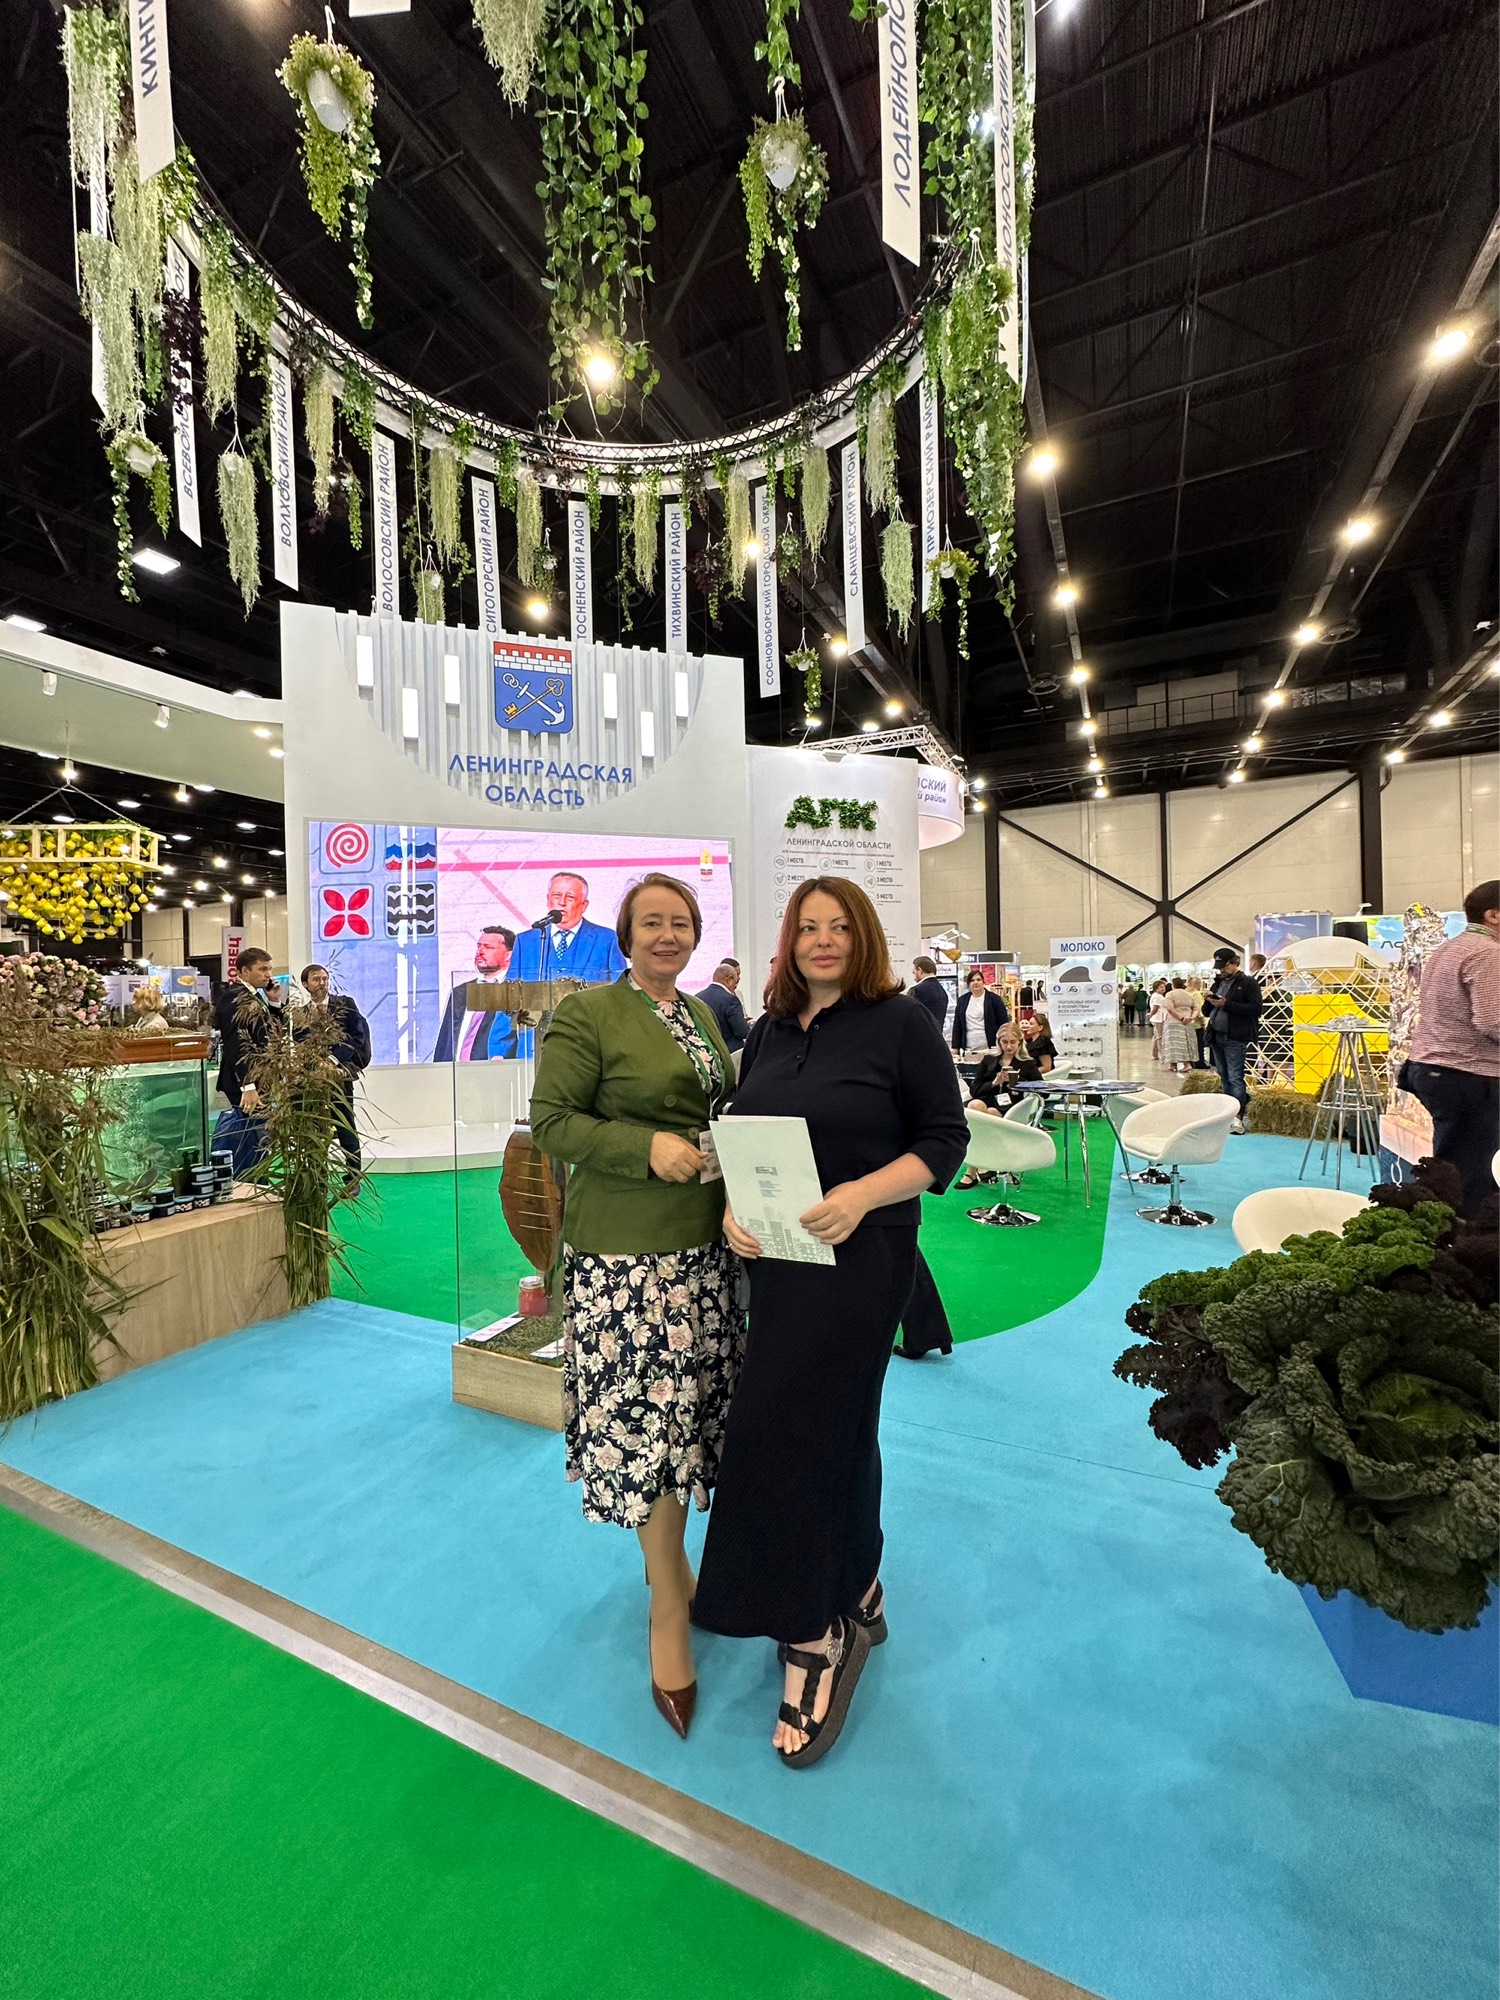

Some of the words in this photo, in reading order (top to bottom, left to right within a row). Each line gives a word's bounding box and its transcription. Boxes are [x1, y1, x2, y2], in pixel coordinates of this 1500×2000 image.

[277, 370, 288, 431] РАЙОН
[276, 432, 292, 548] ВОЛХОВСКИЙ
[377, 443, 391, 497] РАЙОН
[846, 451, 856, 498] РАЙОН
[924, 442, 935, 553] ПРИОЗЕРСКИЙ
[478, 488, 490, 535] РАЙОН
[572, 510, 584, 553] РАЙОН
[669, 512, 681, 554] РАЙОН
[377, 498, 393, 612] ВОЛОСОВСКИЙ
[760, 527, 771, 586] ГОРОДСКОЙ
[846, 502, 858, 596] СЛАНЦЕВСКИЙ
[479, 537, 497, 633] СИТОГОРСКИЙ
[573, 557, 587, 639] ТОСНЕНСКИЙ
[669, 559, 682, 638] ТИХВИНСКИЙ
[763, 591, 774, 686] СОСНОВОБОРСКИЙ
[449, 754, 632, 783] ЛЕНИНГРАДСКАЯ
[485, 784, 585, 806] ОБЛАСТЬ
[784, 795, 879, 832] АПК
[786, 837, 855, 849] ЛЕНИНГРАДСКОЙ
[856, 840, 892, 850] ОБЛАСТИ
[1060, 941, 1105, 952] МОЛОКО
